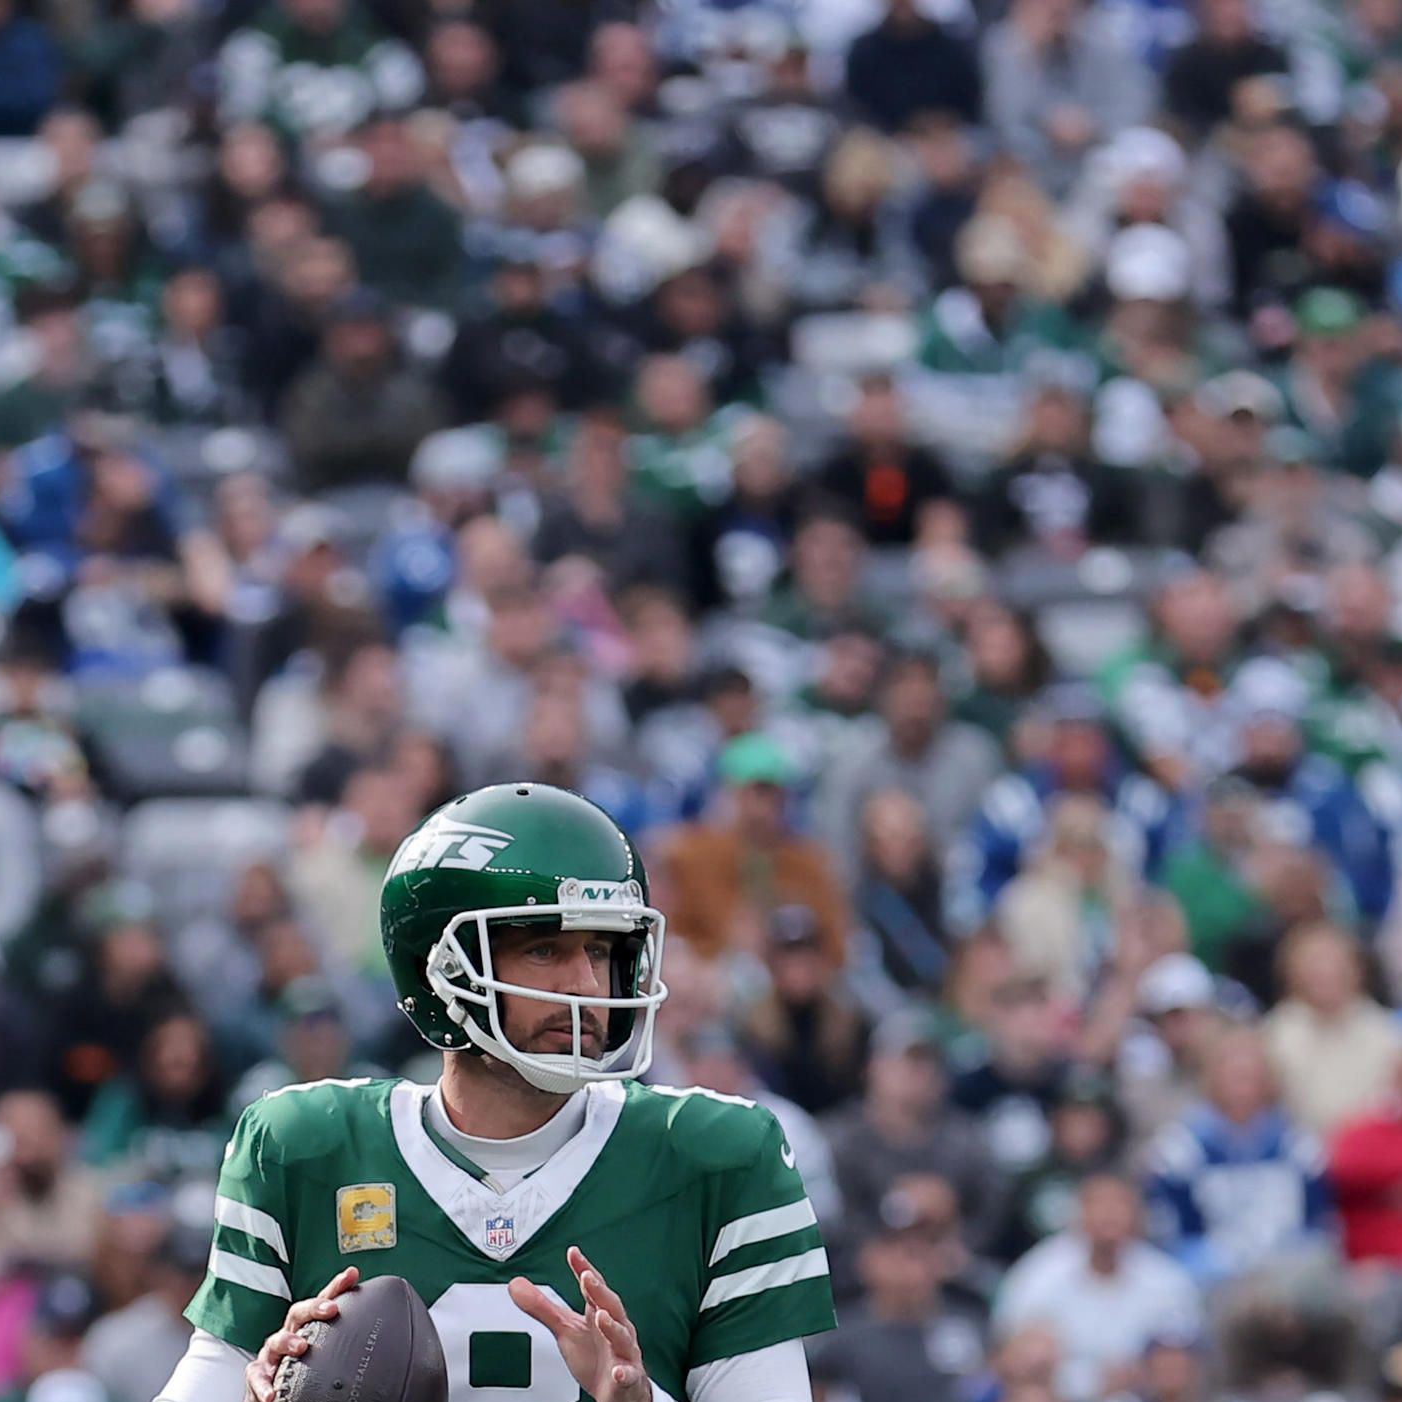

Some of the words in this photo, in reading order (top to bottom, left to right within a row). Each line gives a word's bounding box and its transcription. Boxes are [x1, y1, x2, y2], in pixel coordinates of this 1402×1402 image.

[582, 887, 617, 900] NY
[341, 1188, 391, 1235] C
[489, 1230, 512, 1246] NFL
